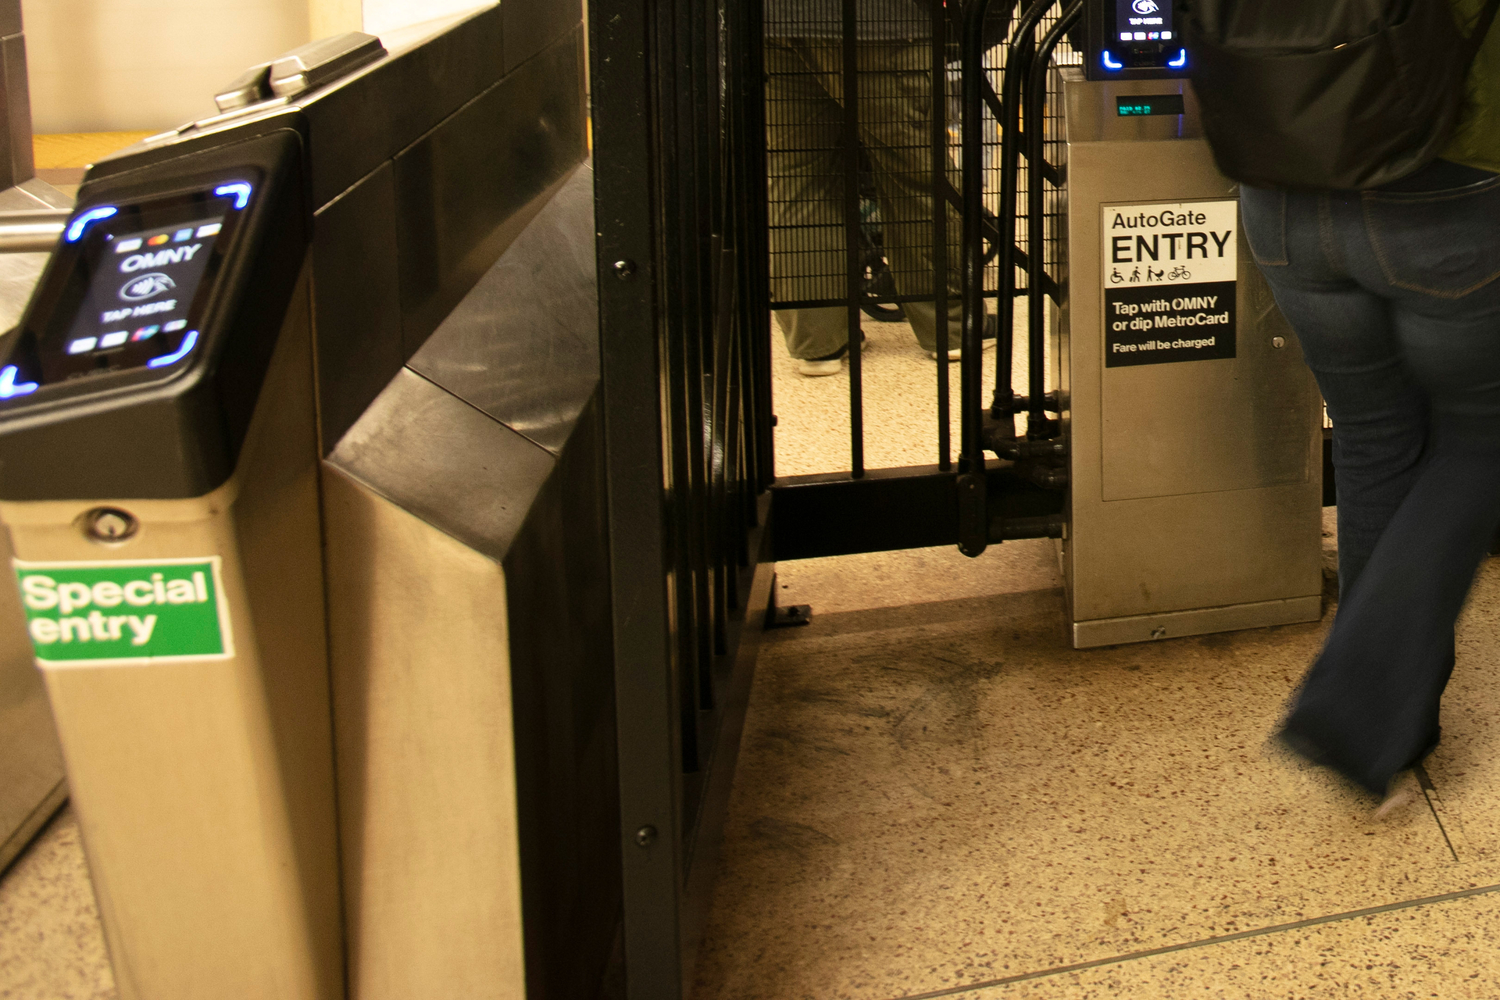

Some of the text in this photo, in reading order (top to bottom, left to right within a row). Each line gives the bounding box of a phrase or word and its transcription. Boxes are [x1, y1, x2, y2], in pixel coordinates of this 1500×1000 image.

[1112, 210, 1206, 229] AutoGate
[120, 243, 203, 273] OMNY
[1112, 230, 1232, 263] ENTRY
[101, 298, 178, 324] TAP HERE
[1112, 295, 1218, 316] Tap with OMNY
[1112, 311, 1229, 332] or dip MetroCard
[1112, 336, 1216, 354] Fare will be charged
[22, 571, 209, 616] Special
[29, 611, 157, 647] entry
